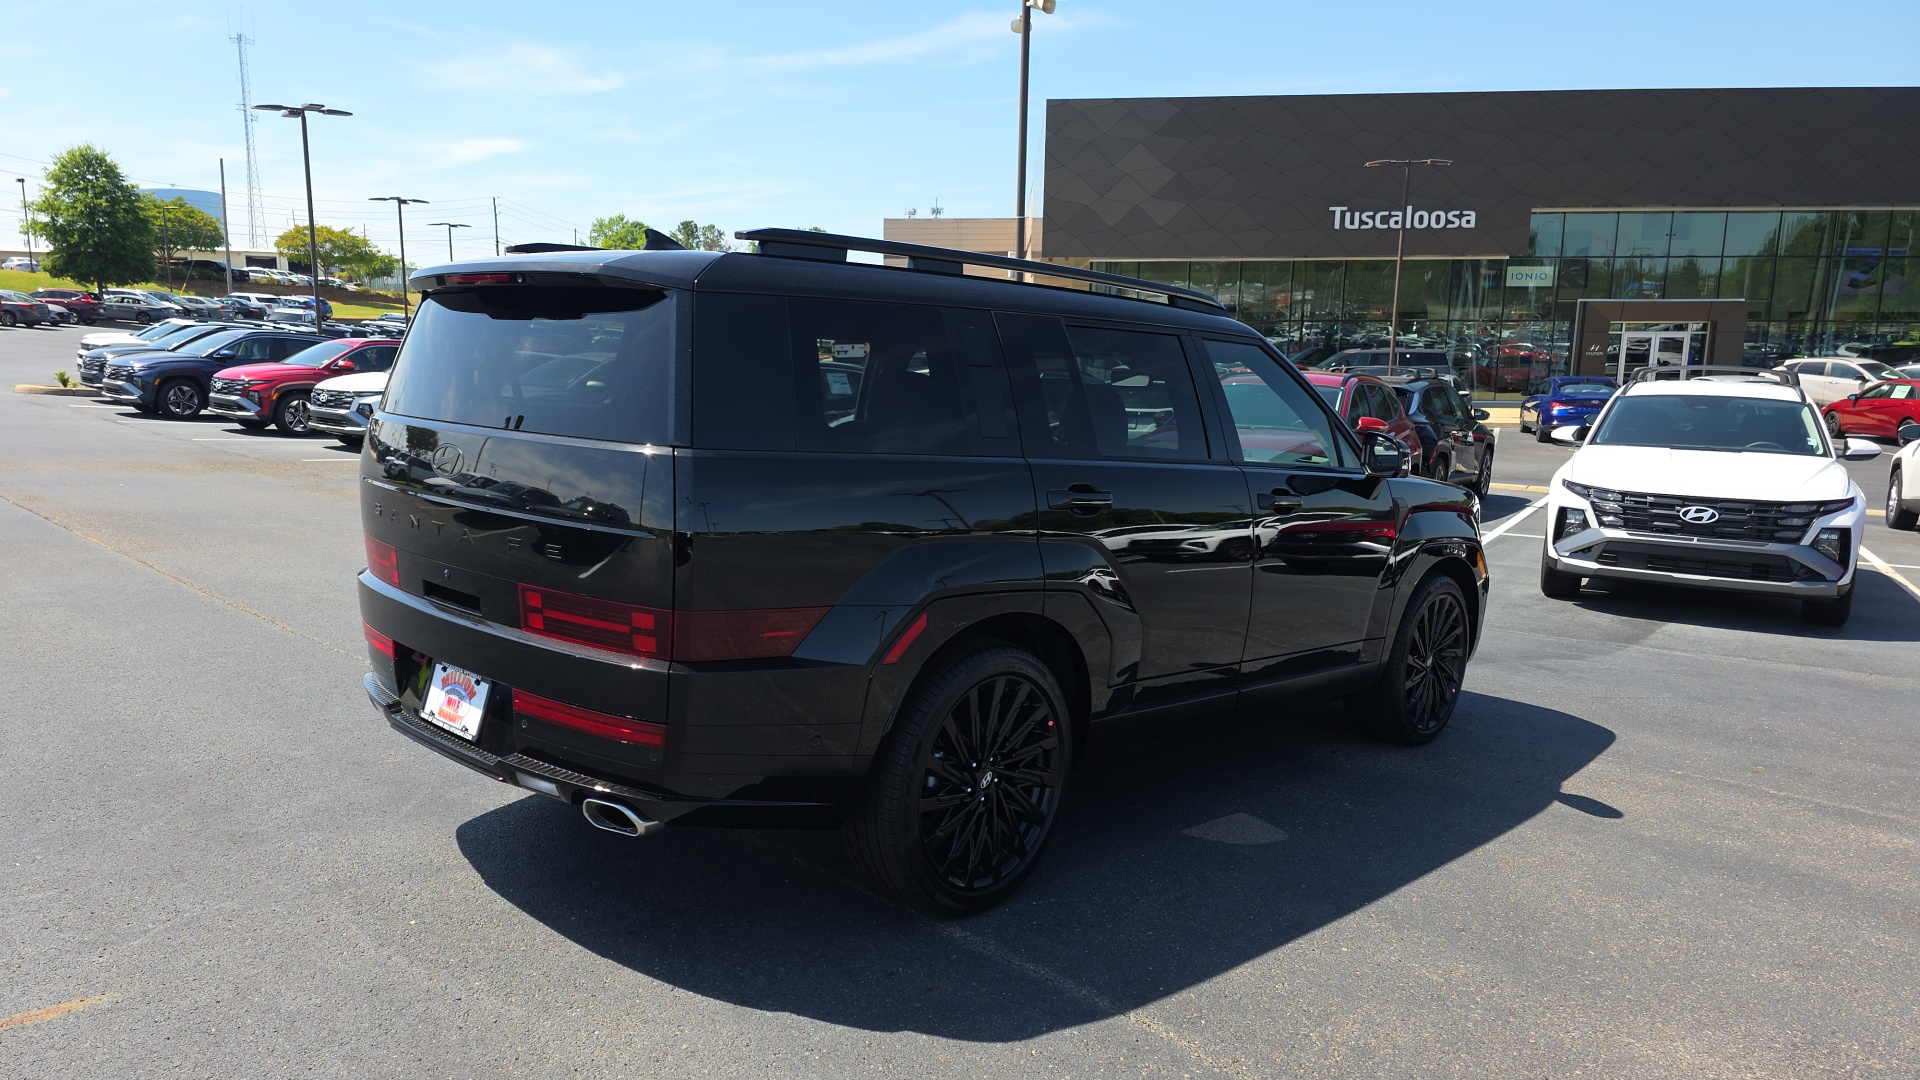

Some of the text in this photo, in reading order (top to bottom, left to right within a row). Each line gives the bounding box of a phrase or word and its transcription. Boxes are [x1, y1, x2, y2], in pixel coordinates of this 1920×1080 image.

[1329, 205, 1476, 230] Tuscaloosa
[1511, 272, 1548, 281] IONIQ
[374, 502, 562, 560] SANTA FE
[441, 670, 477, 701] MILLION
